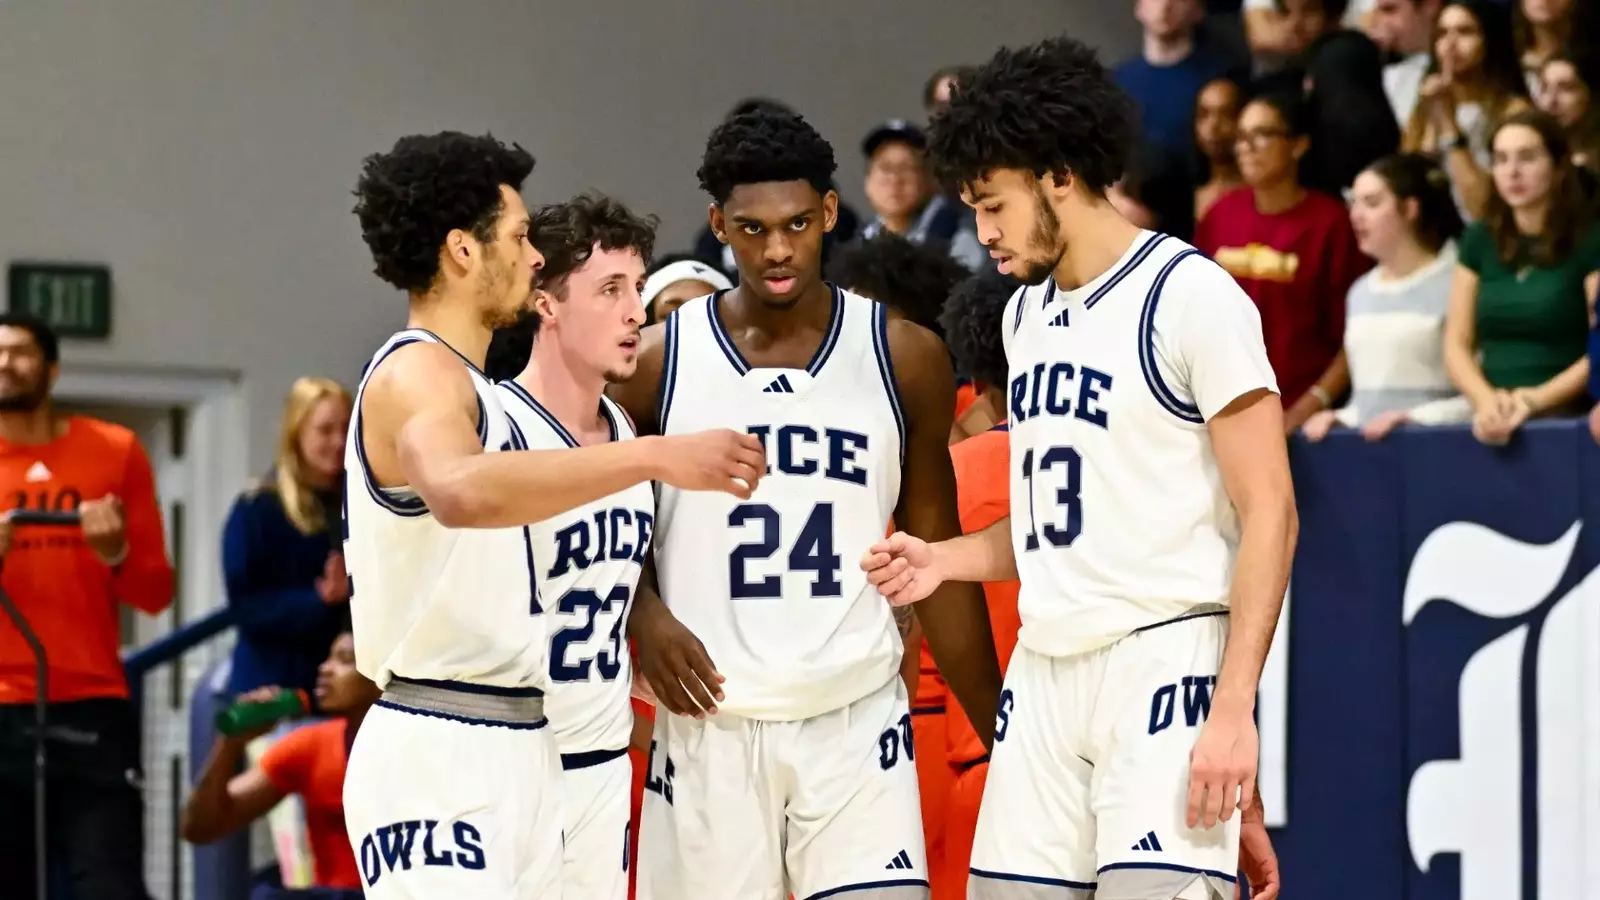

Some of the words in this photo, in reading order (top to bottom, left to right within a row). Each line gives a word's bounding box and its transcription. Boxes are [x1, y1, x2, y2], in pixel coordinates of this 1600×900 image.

[1010, 361, 1113, 430] RICE
[746, 423, 869, 487] ICE
[1021, 445, 1083, 553] 13
[546, 506, 655, 580] RICE
[727, 501, 844, 600] 24
[548, 583, 631, 683] 23
[1147, 674, 1217, 736] OW
[645, 739, 675, 807] LS
[361, 819, 486, 887] OWLS
